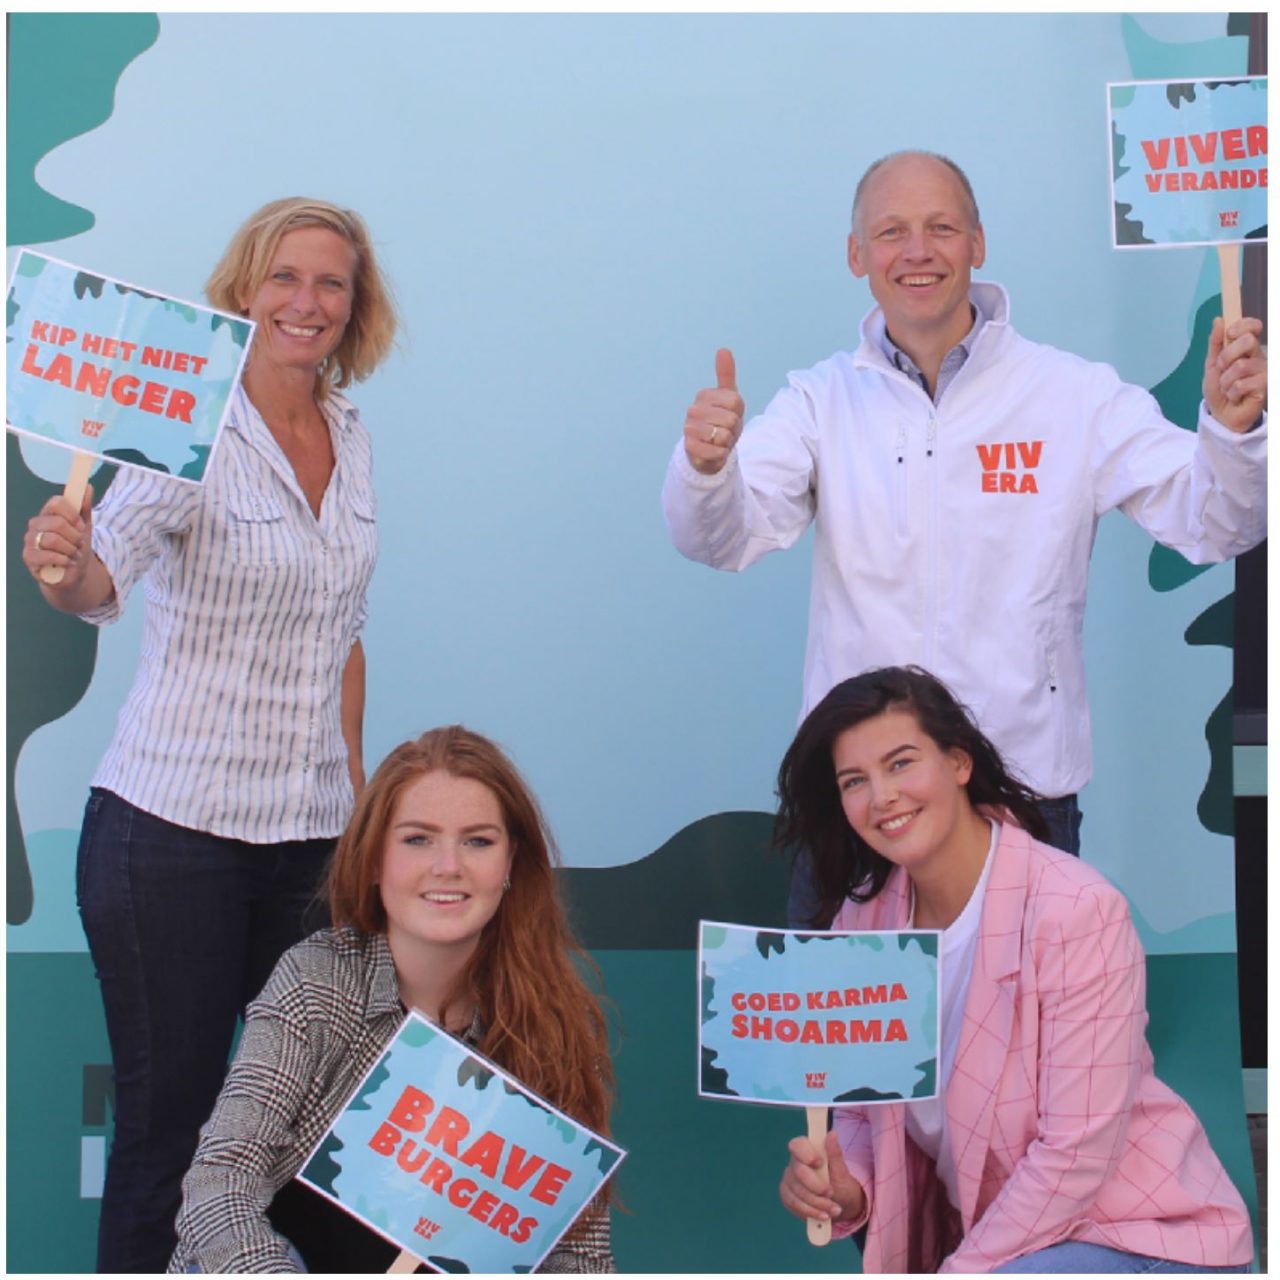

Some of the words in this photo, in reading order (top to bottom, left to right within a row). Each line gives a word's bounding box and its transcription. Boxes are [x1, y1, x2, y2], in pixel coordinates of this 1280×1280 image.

[31, 320, 77, 346] KIP
[81, 333, 137, 361] HET
[141, 347, 208, 375] NIET
[21, 343, 196, 424] LANGER
[976, 441, 1043, 471] VIV
[982, 472, 1039, 494] ERA
[731, 992, 801, 1011] GOED
[806, 983, 908, 1009] KARMA
[731, 1014, 908, 1044] SHOARMA
[388, 1085, 572, 1206] BRAVE
[368, 1122, 538, 1243] BURGERS
